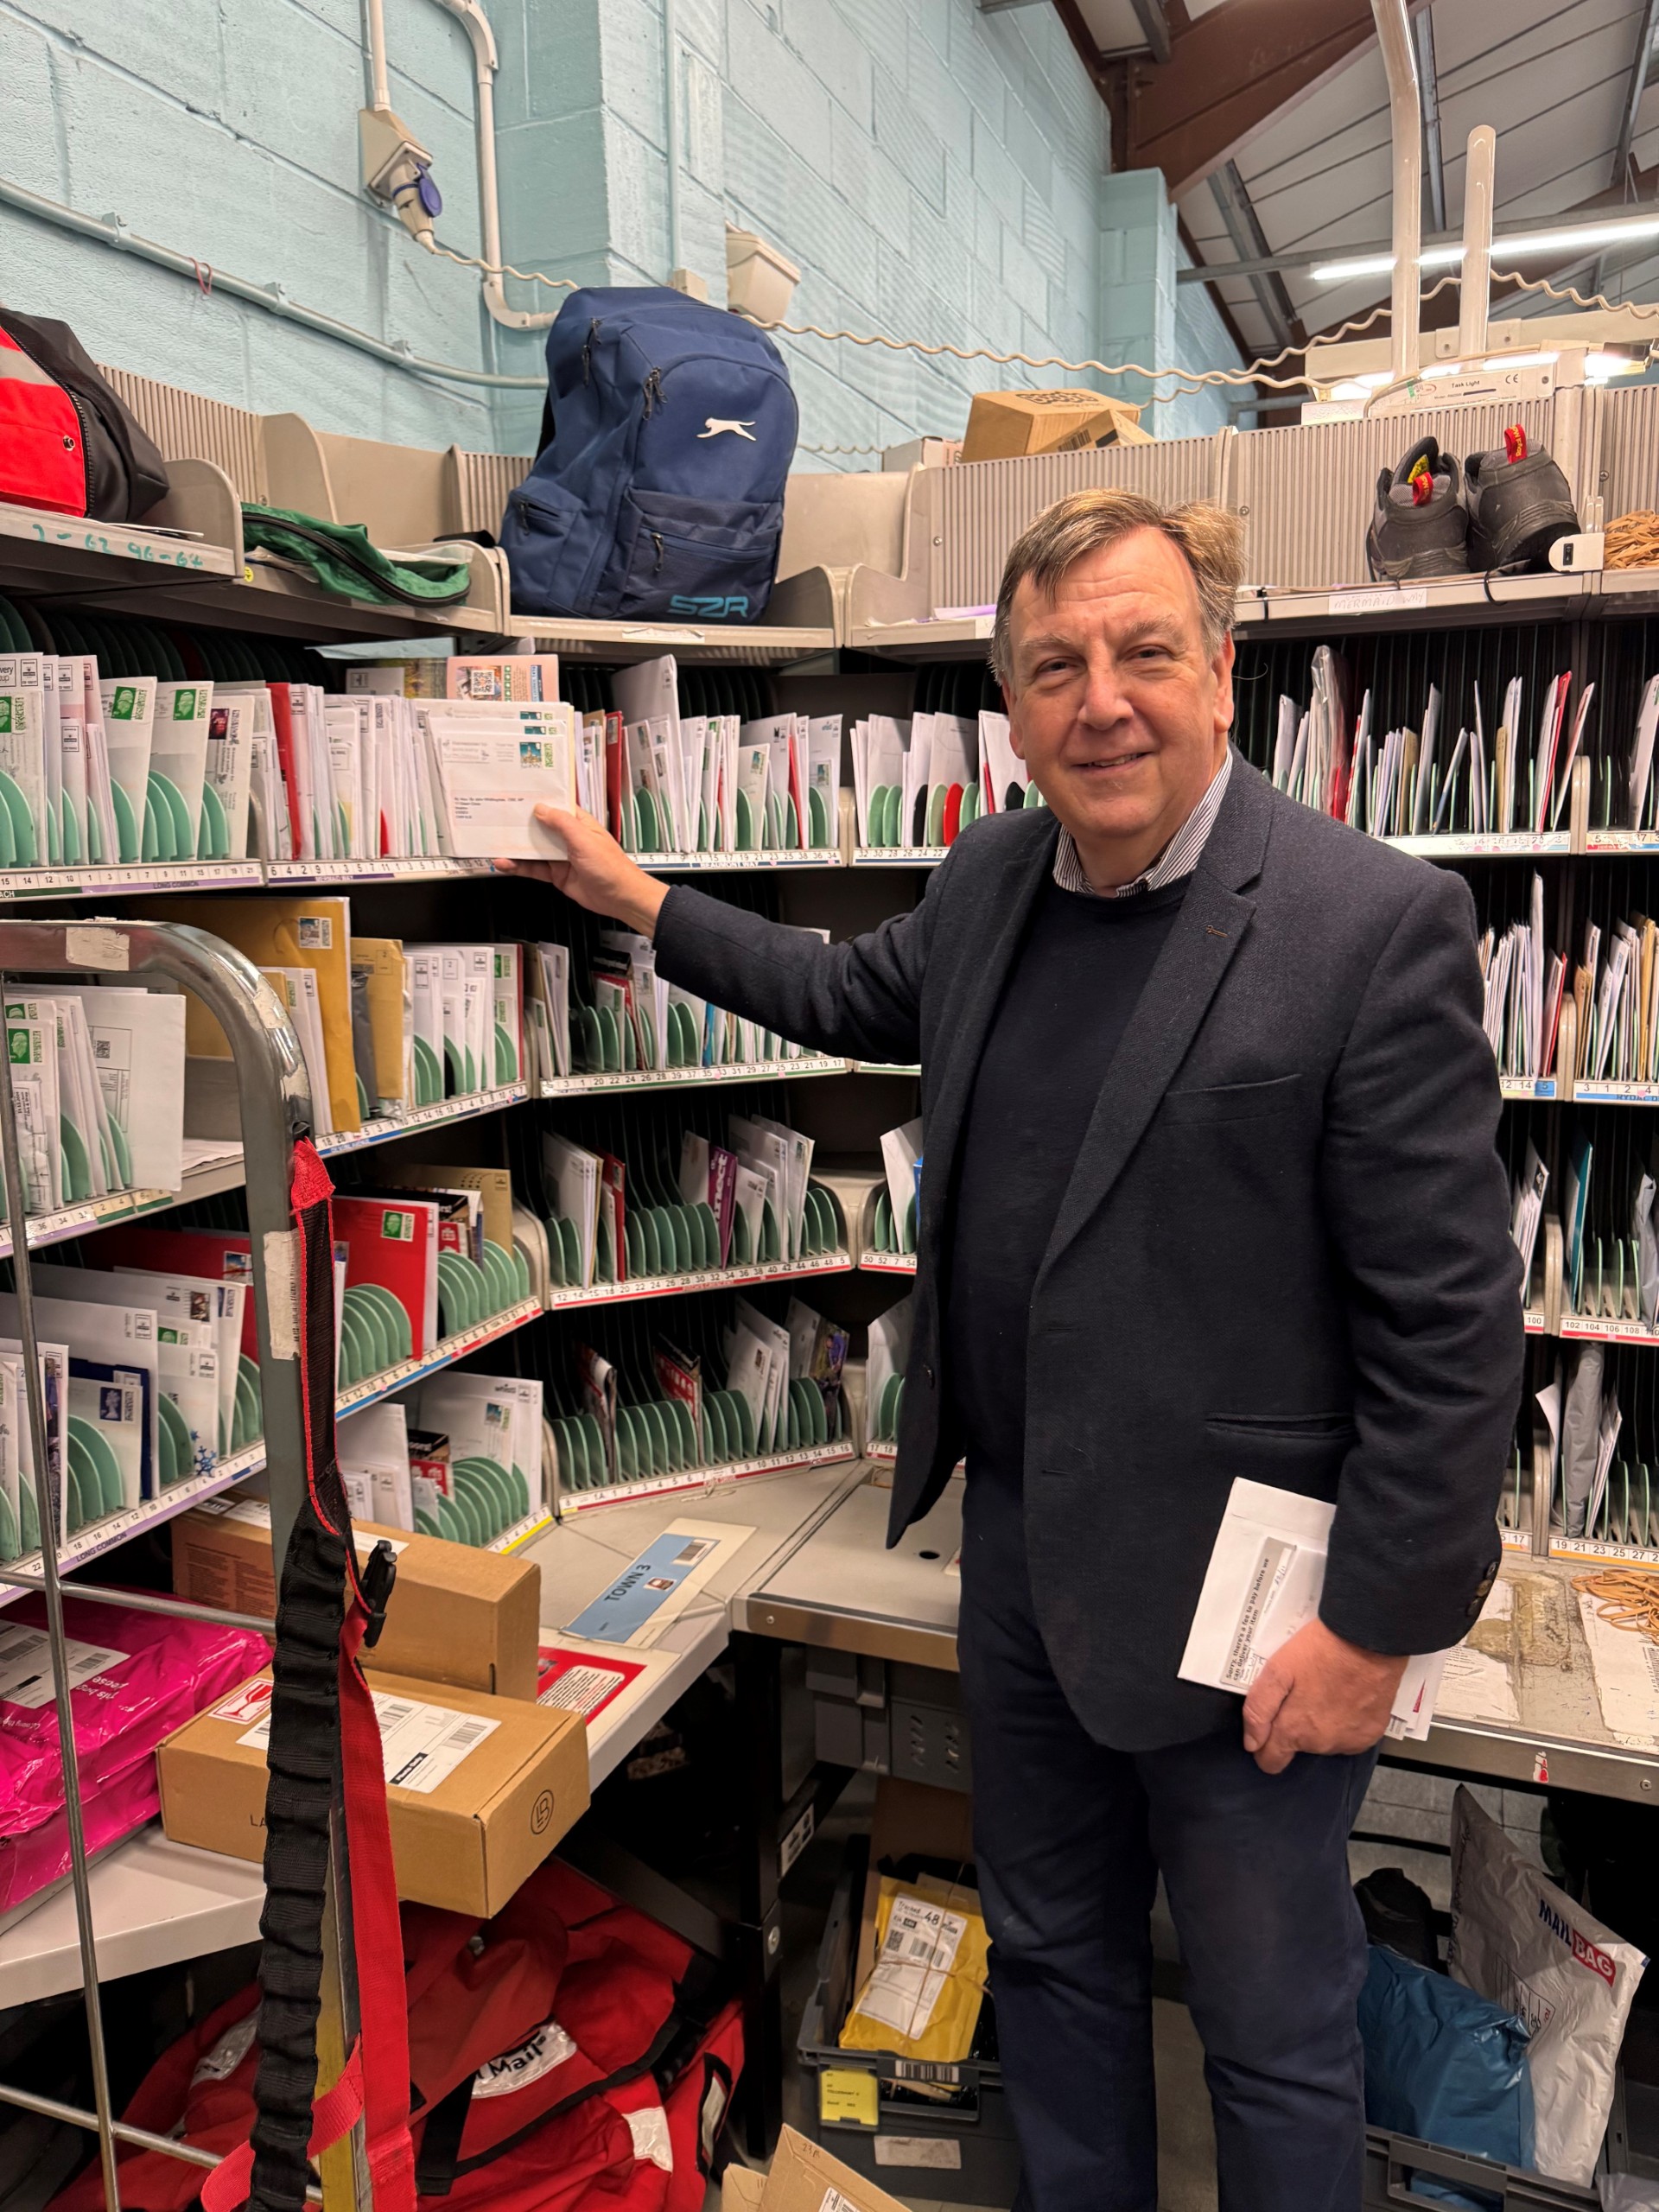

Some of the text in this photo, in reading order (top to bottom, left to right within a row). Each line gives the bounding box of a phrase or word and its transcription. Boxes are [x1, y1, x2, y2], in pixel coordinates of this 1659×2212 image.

[666, 594, 749, 618] SZR
[1334, 596, 1395, 610] MERMAID
[1402, 592, 1424, 604] WAY
[271, 867, 276, 876] 6
[286, 866, 292, 874] 4
[302, 866, 308, 874] 2
[153, 881, 171, 890] LONG
[336, 1134, 346, 1143] 20
[412, 1114, 421, 1123] 12
[59, 1217, 68, 1225] 34
[31, 1561, 41, 1572] 22
[73, 1541, 83, 1551] 18
[92, 1532, 101, 1541] 16
[112, 1522, 121, 1531] 14
[130, 1512, 140, 1521] 12
[149, 1503, 157, 1512] 10
[75, 1532, 127, 1562] LONG COMMON
[1555, 1541, 1645, 1560] 19 21 23 25 27
[604, 1572, 645, 1601] TOWN
[1253, 1569, 1266, 1591] before
[1249, 1592, 1259, 1605] pay
[1242, 1616, 1250, 1628] fee
[1232, 1636, 1243, 1656] there's
[1237, 1646, 1249, 1667] deliver
[1245, 1626, 1254, 1643] your
[1250, 1609, 1259, 1625] item
[1225, 1658, 1237, 1680] Sorry,
[899, 1901, 921, 1913] Tracked
[925, 1911, 940, 1925] 48
[1539, 1899, 1613, 1977] MAIL BAG
[488, 2043, 543, 2077] Mail
